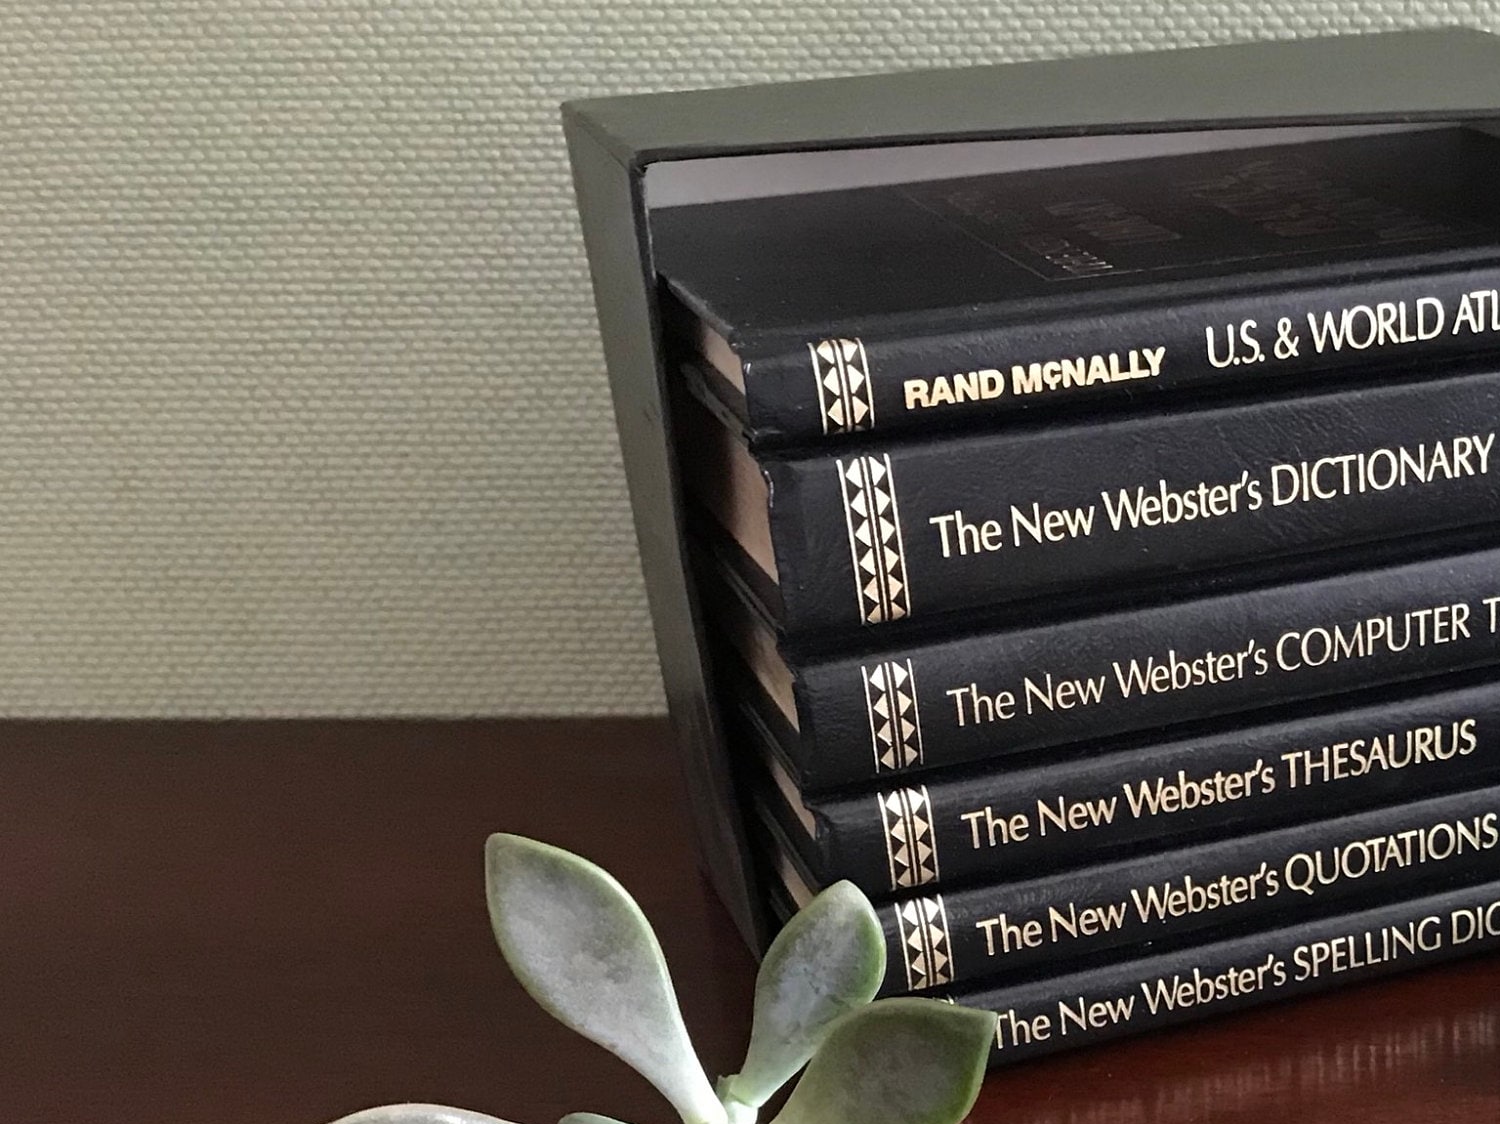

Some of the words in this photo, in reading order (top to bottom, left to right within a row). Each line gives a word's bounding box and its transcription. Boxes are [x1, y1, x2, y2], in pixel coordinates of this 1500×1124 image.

[903, 368, 1005, 410] RAND
[1205, 318, 1266, 368] U.S.
[1273, 316, 1300, 360] &
[1306, 296, 1445, 354] WORLD
[928, 509, 1003, 558] The
[1010, 502, 1095, 547] New
[1100, 470, 1263, 531] Webster's
[1270, 432, 1496, 507] DICTIONARY
[945, 682, 1016, 727] The
[1023, 673, 1106, 715] New
[1112, 638, 1269, 699] Webster's
[1275, 602, 1471, 671] COMPUTER
[960, 806, 1030, 849] The
[1037, 795, 1118, 837] New
[1122, 758, 1276, 819] Webster's
[1280, 717, 1477, 789] THESAURUS
[975, 912, 1043, 956] The
[1048, 901, 1127, 943] New
[1130, 861, 1280, 924] Webster's
[1284, 812, 1499, 896] QUOTATIONS
[1058, 994, 1135, 1036] New
[1140, 953, 1287, 1015] Webster's
[1293, 915, 1442, 981] SPELLING
